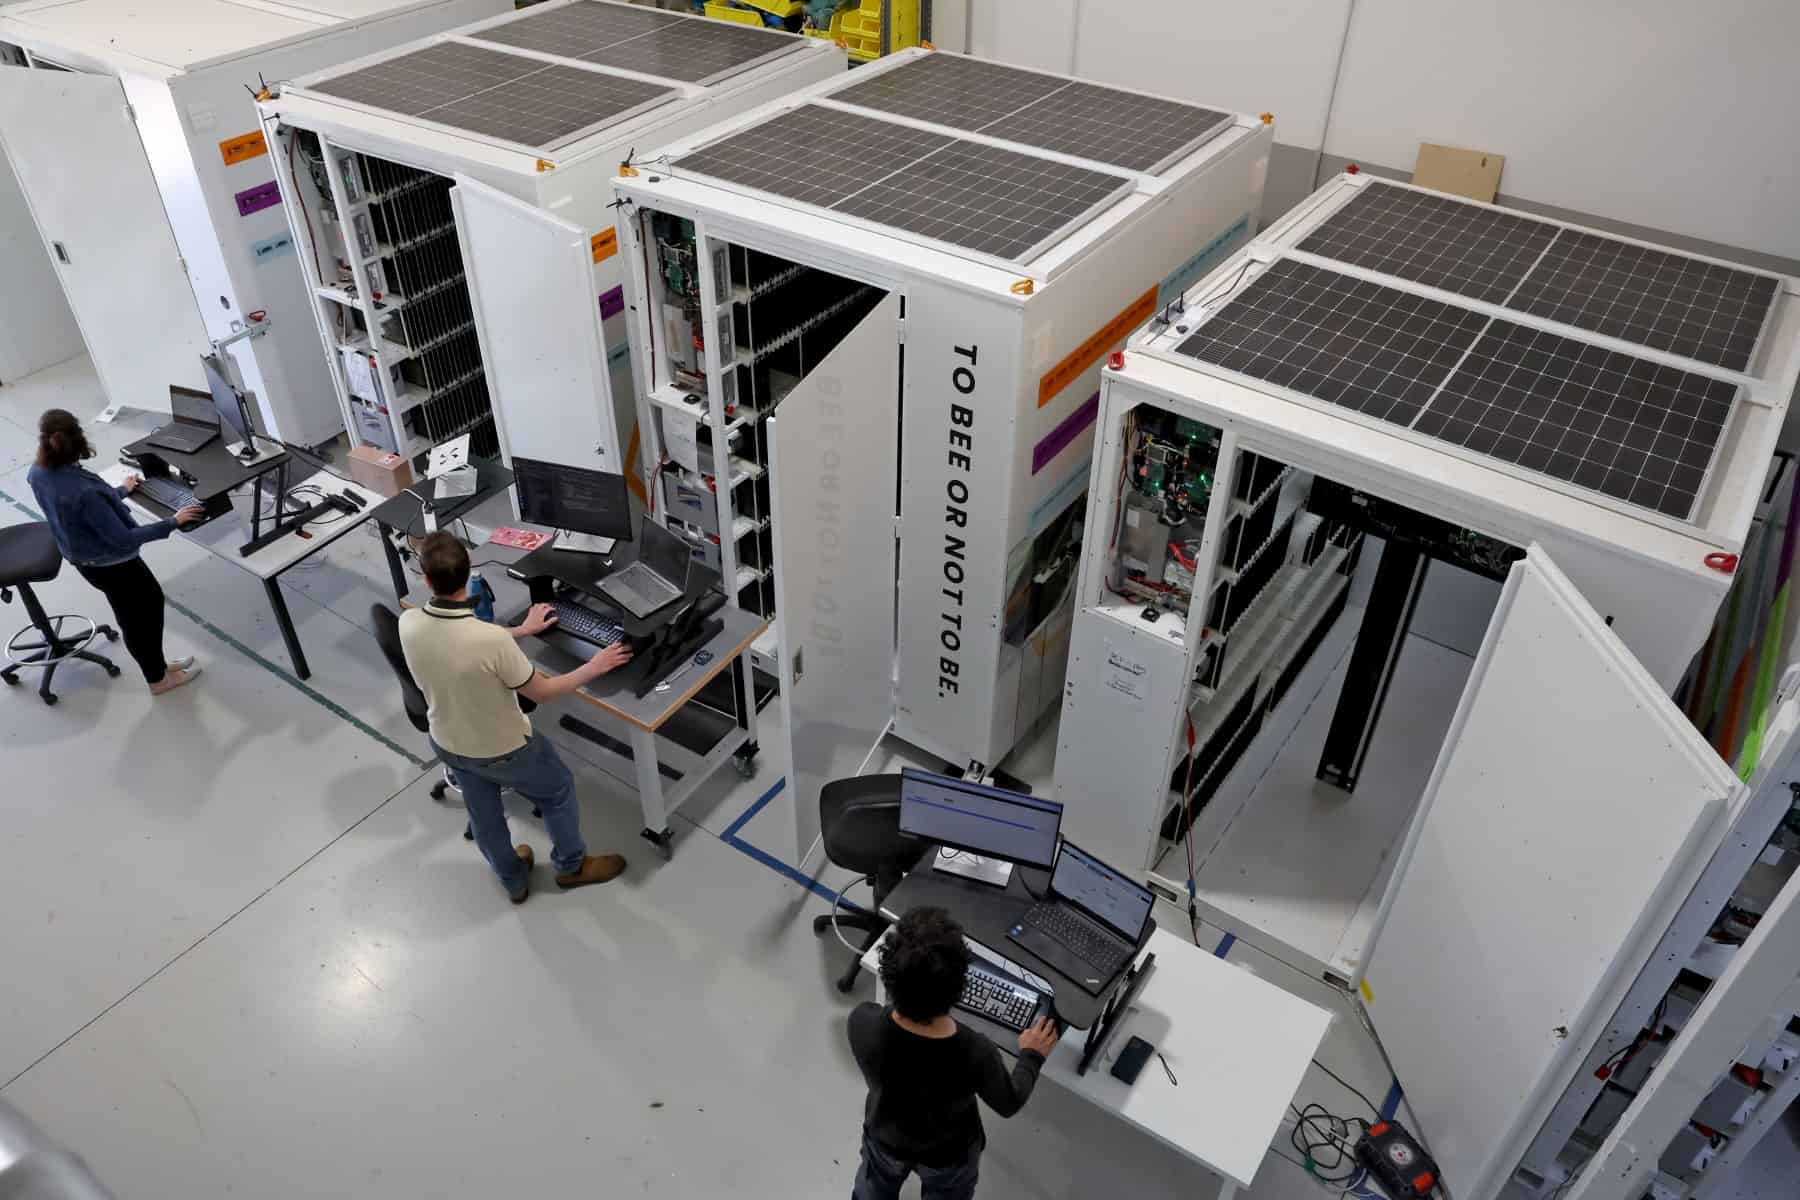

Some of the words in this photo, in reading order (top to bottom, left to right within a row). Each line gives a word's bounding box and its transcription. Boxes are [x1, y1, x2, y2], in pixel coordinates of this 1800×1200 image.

[953, 345, 978, 394] TO
[949, 404, 974, 472] BEE
[946, 480, 969, 528] OR
[943, 534, 966, 606] NOT
[940, 613, 962, 652] TO
[938, 656, 960, 697] BE.
